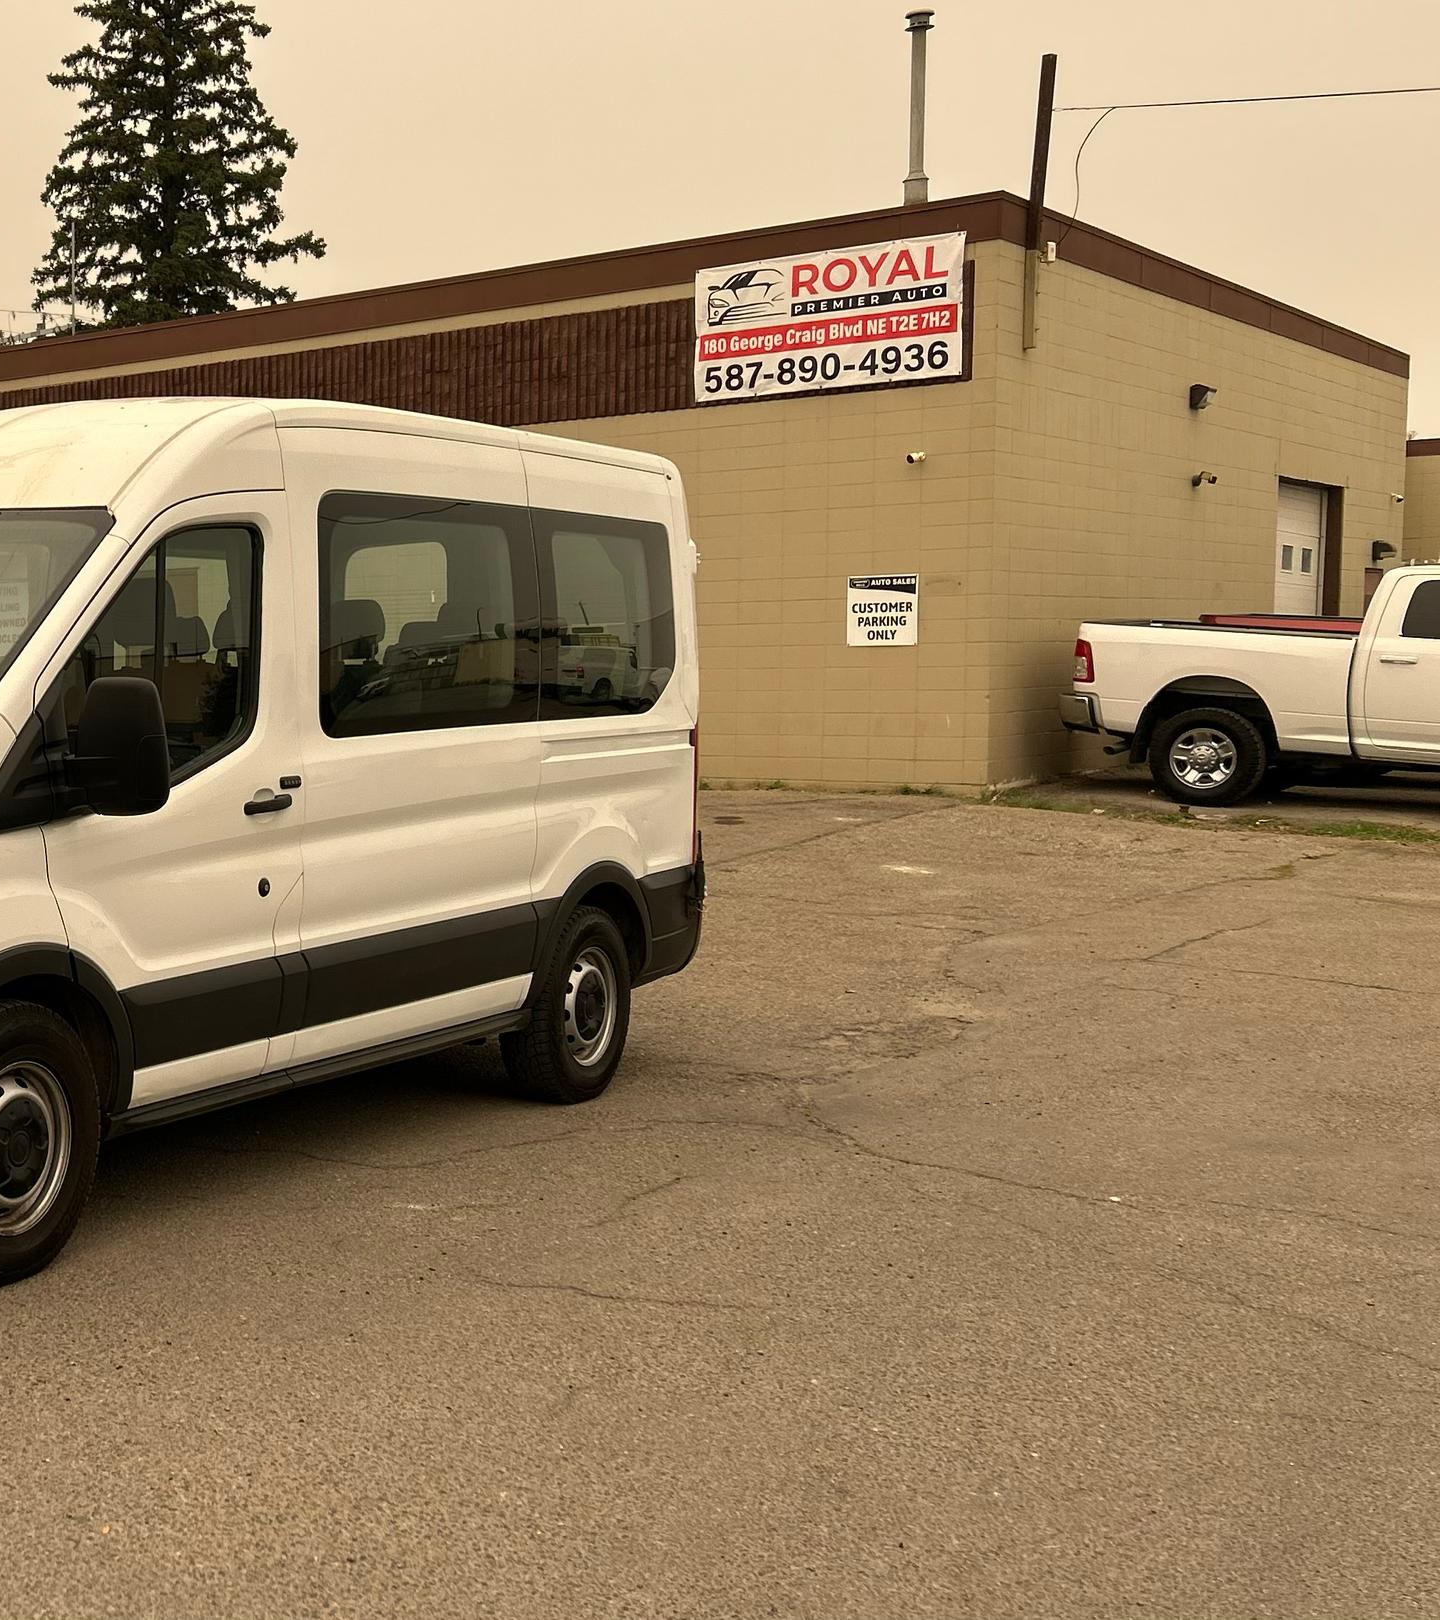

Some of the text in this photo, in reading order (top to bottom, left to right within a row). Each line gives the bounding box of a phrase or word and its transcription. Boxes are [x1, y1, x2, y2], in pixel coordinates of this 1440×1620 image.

[791, 246, 949, 298] ROYAL
[794, 285, 943, 315] PREMIER AUTO
[703, 310, 951, 355] 180 George Craig Blvd NE T2E 7H2
[704, 340, 950, 393] 587-890-4936
[852, 602, 913, 613] CUSTOMER
[857, 616, 907, 627] PARKING
[867, 630, 897, 640] ONLY
